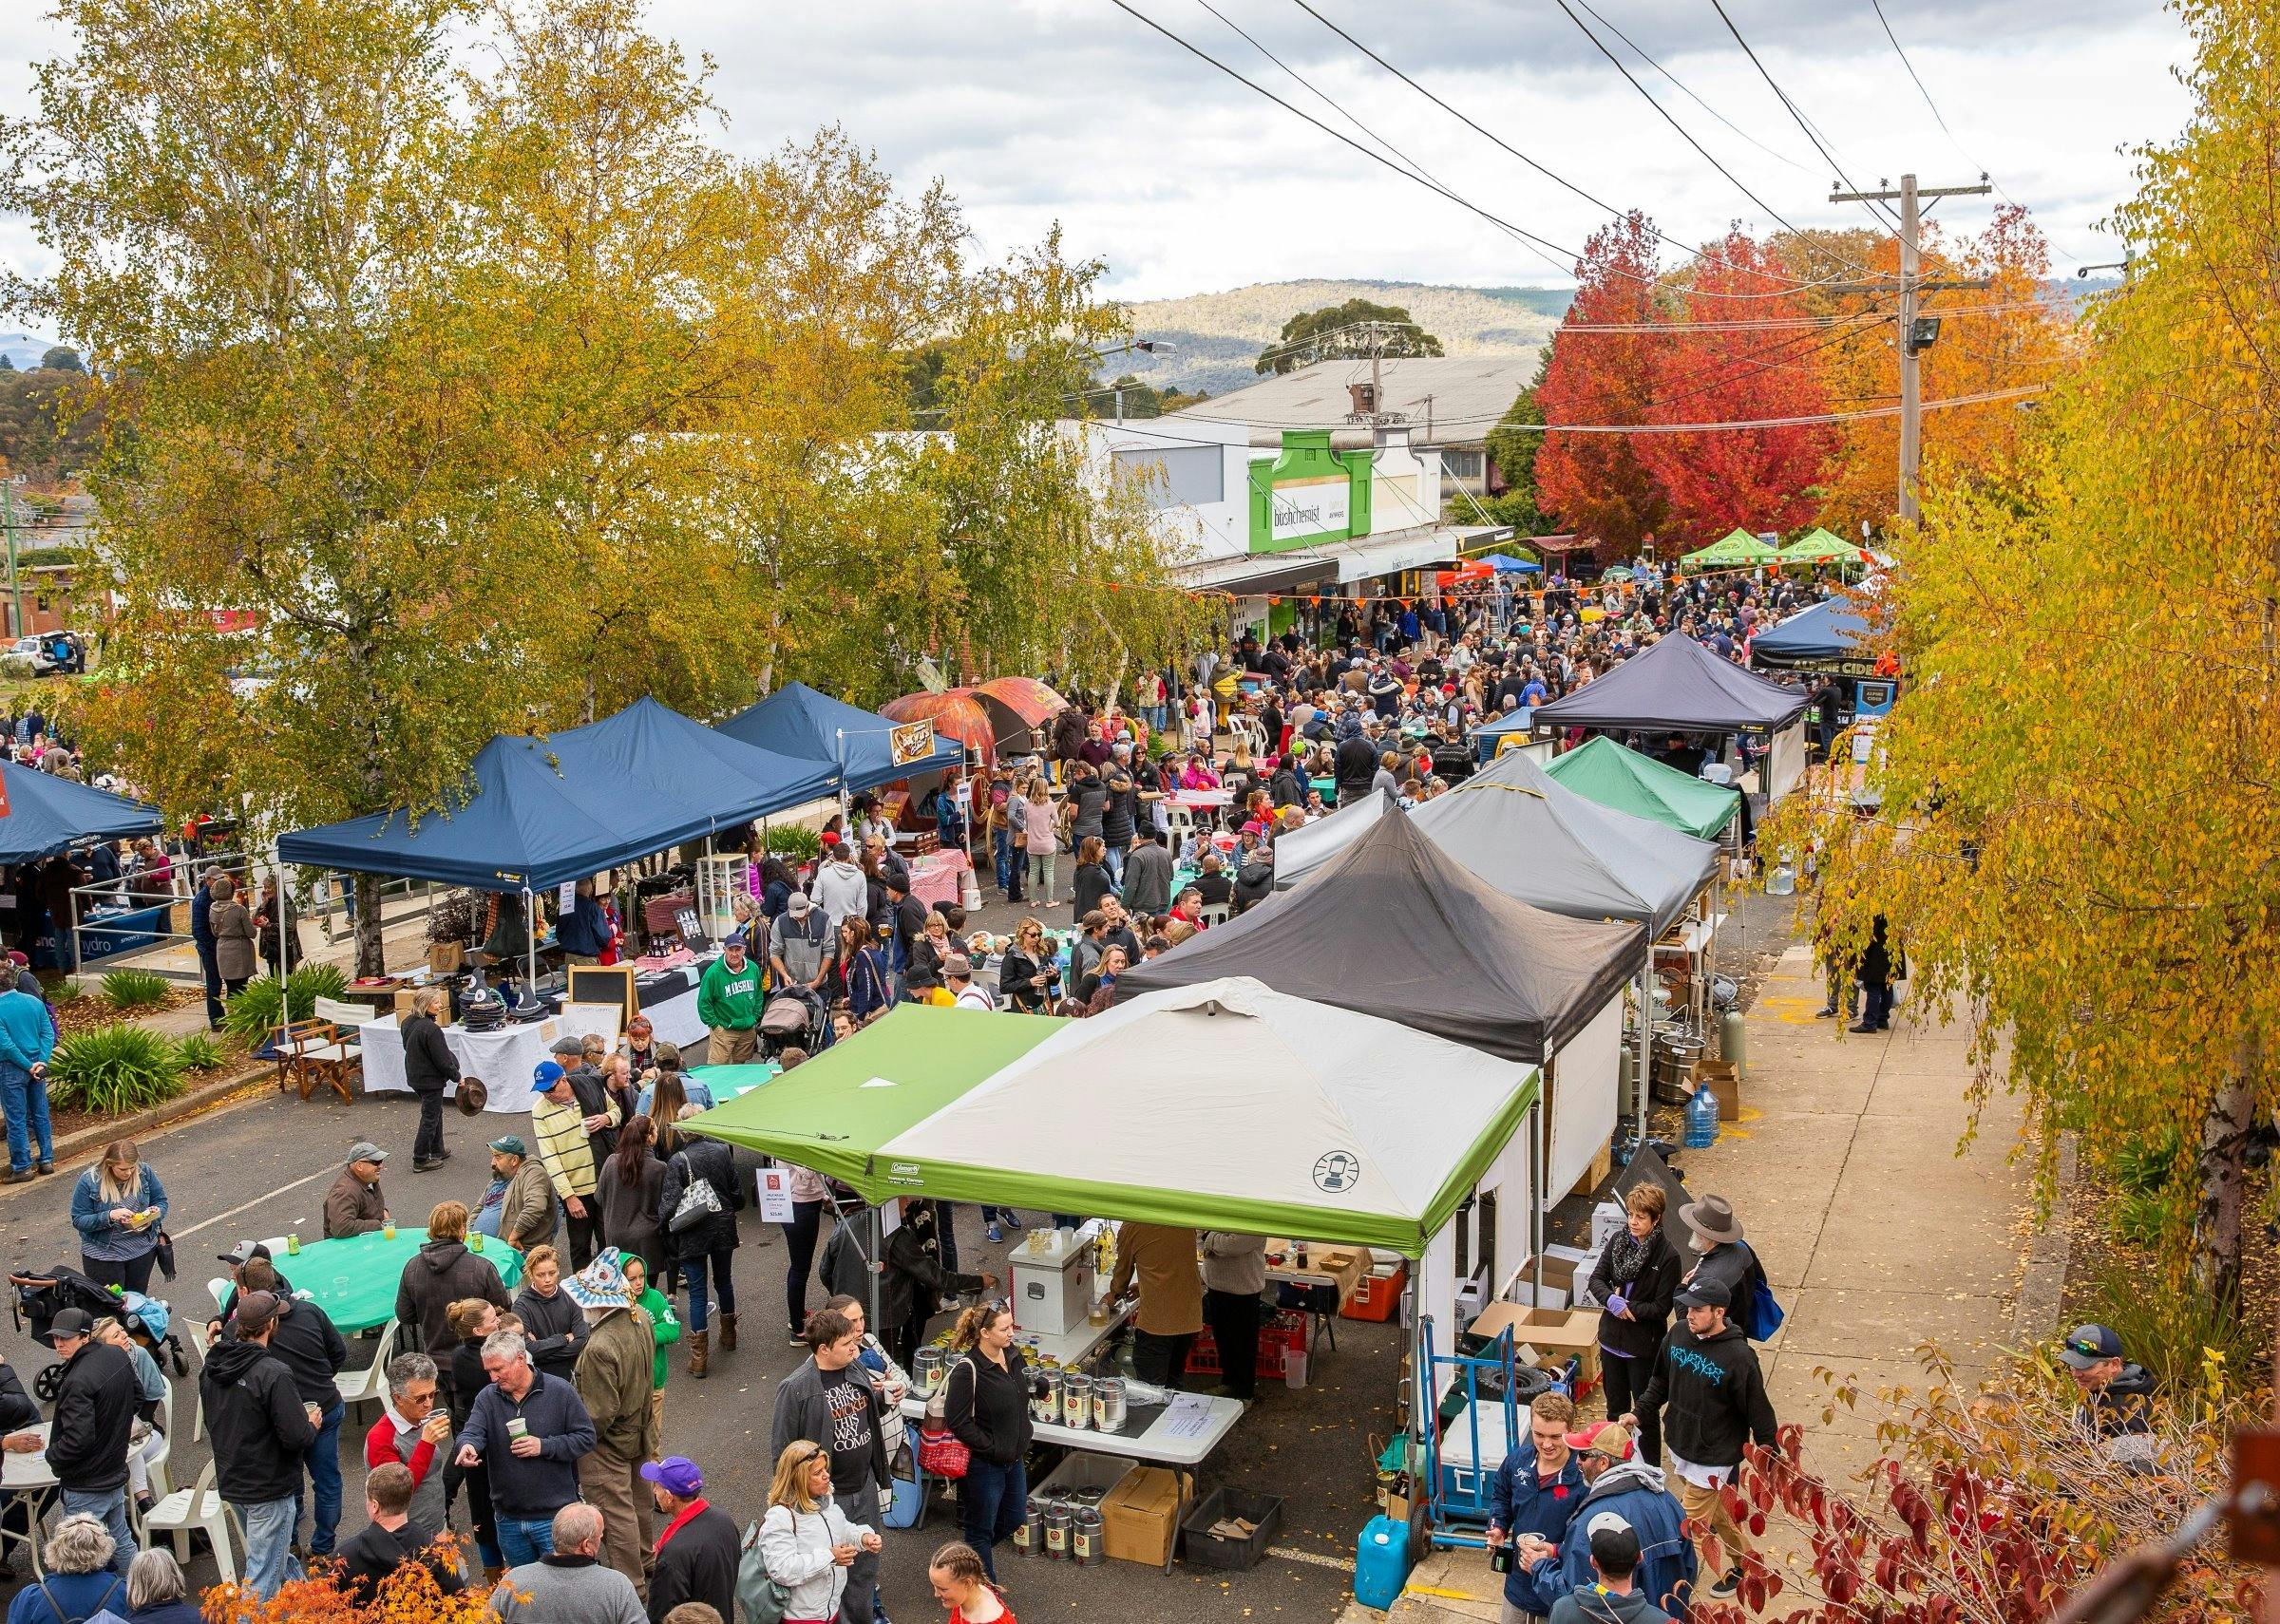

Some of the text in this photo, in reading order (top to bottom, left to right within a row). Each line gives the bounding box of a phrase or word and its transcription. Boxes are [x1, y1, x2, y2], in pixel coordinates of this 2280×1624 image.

[1274, 504, 1320, 527] bushchemist
[1792, 659, 1874, 677] ALPINE CIDE
[1670, 1345, 1726, 1385] REVENGE
[827, 1388, 862, 1411] THING
[830, 1395, 869, 1420] WICKED
[834, 1413, 860, 1430] THIS
[834, 1425, 859, 1441] WAY
